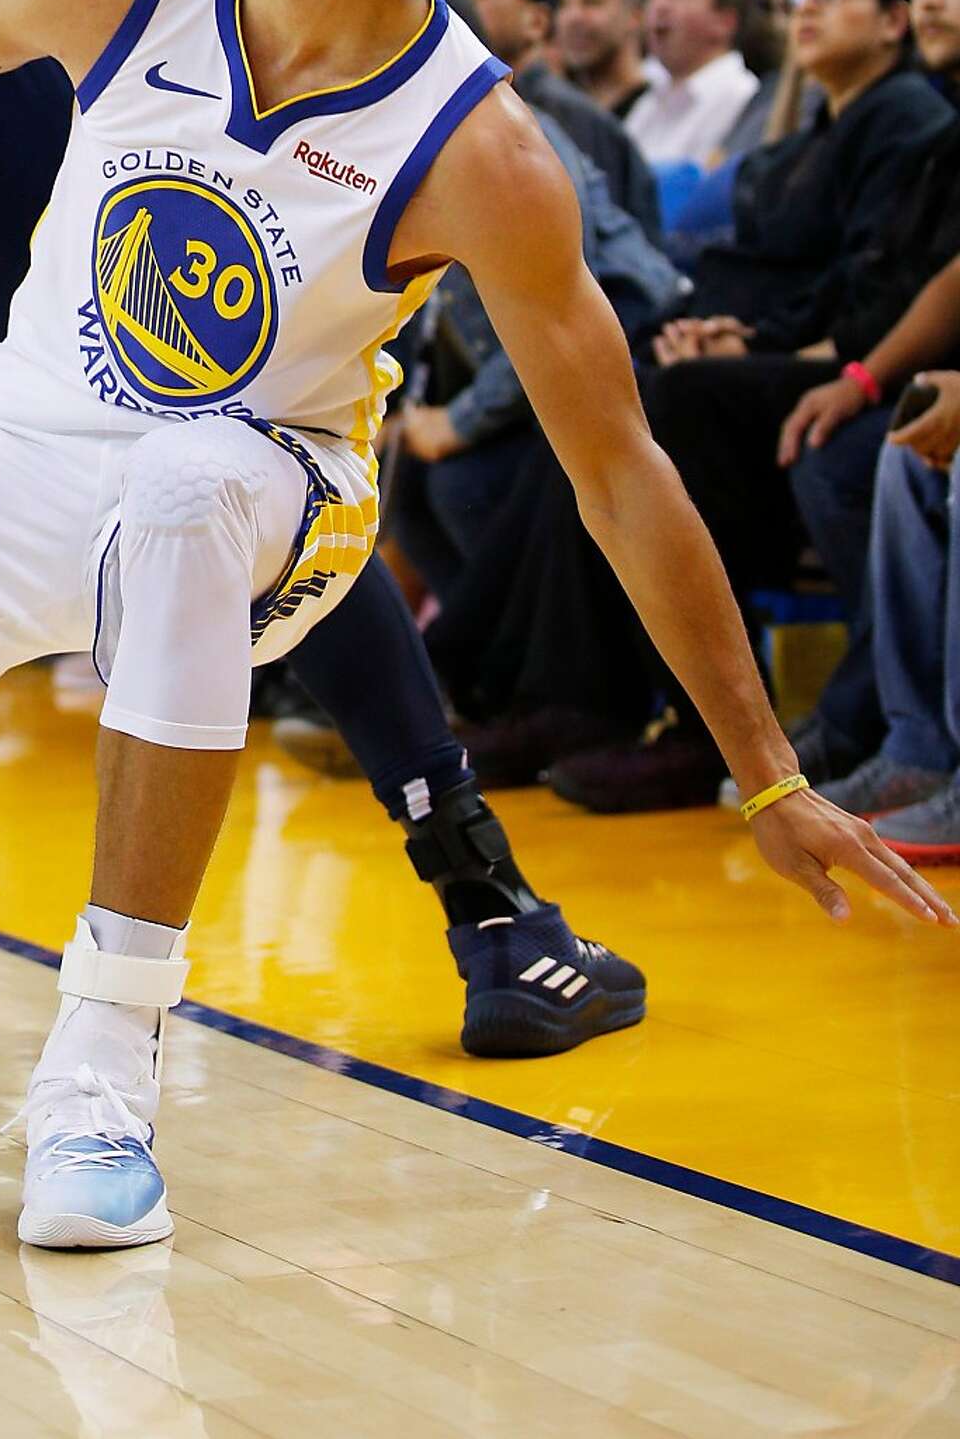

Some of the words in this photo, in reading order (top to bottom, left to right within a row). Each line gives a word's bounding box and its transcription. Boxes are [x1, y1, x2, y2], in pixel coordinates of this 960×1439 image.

[102, 150, 234, 190] GOLDEN
[243, 187, 303, 287] STATE
[293, 141, 378, 196] Rakuten
[169, 240, 255, 321] 30
[78, 298, 254, 422] WARRS
